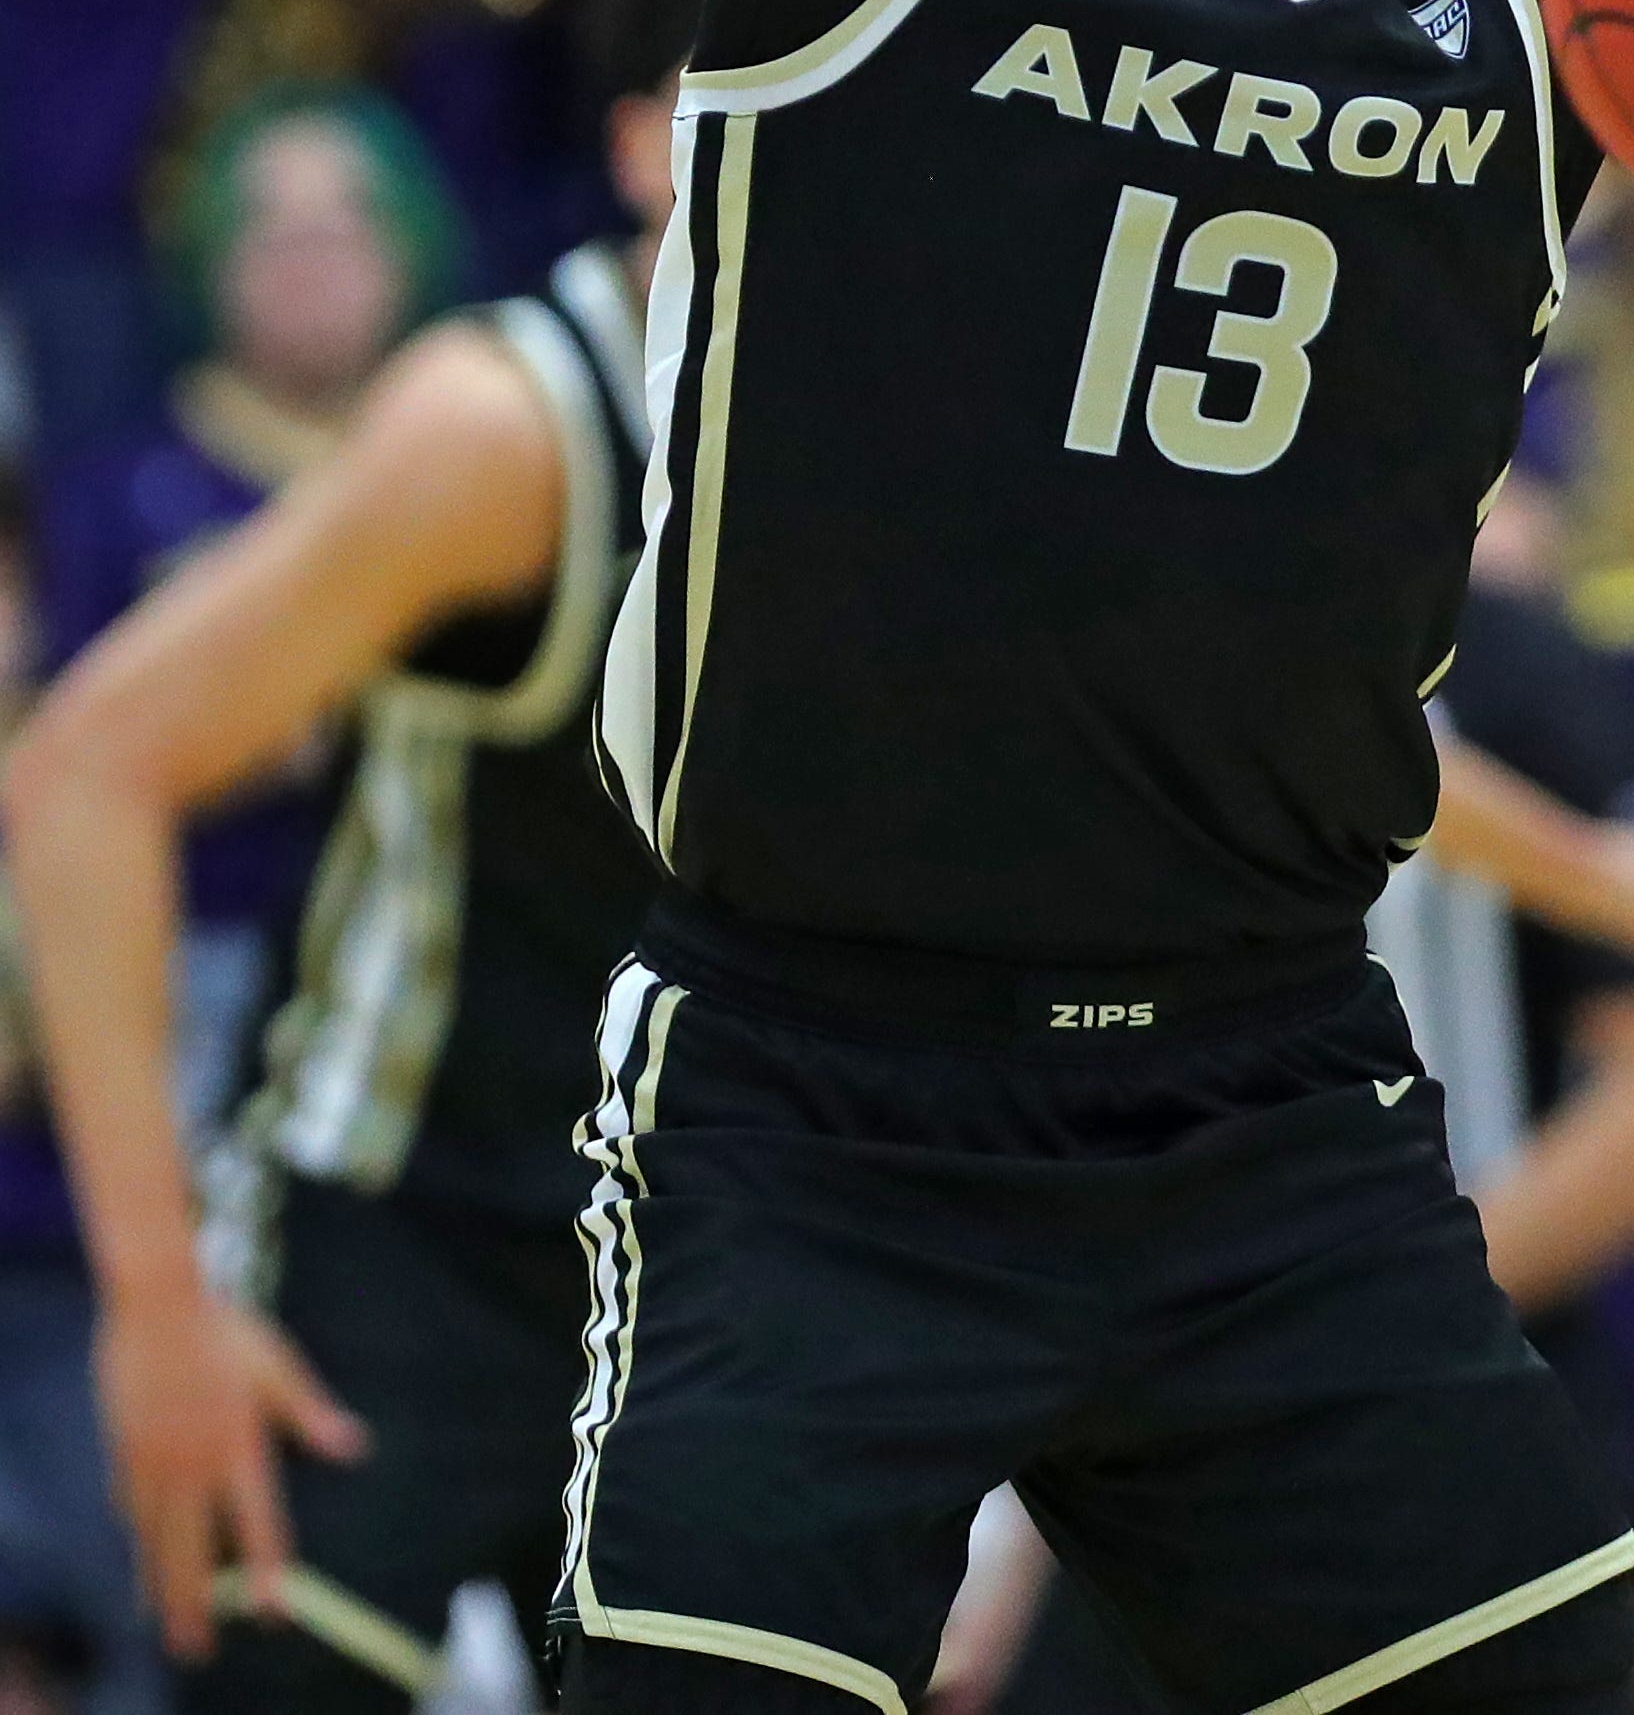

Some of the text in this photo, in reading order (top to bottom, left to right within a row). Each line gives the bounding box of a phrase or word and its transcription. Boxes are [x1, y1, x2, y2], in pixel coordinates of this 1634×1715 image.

[970, 23, 1506, 185] AKRON
[1063, 184, 1339, 475] 13
[1050, 1002, 1154, 1028] ZIPS
